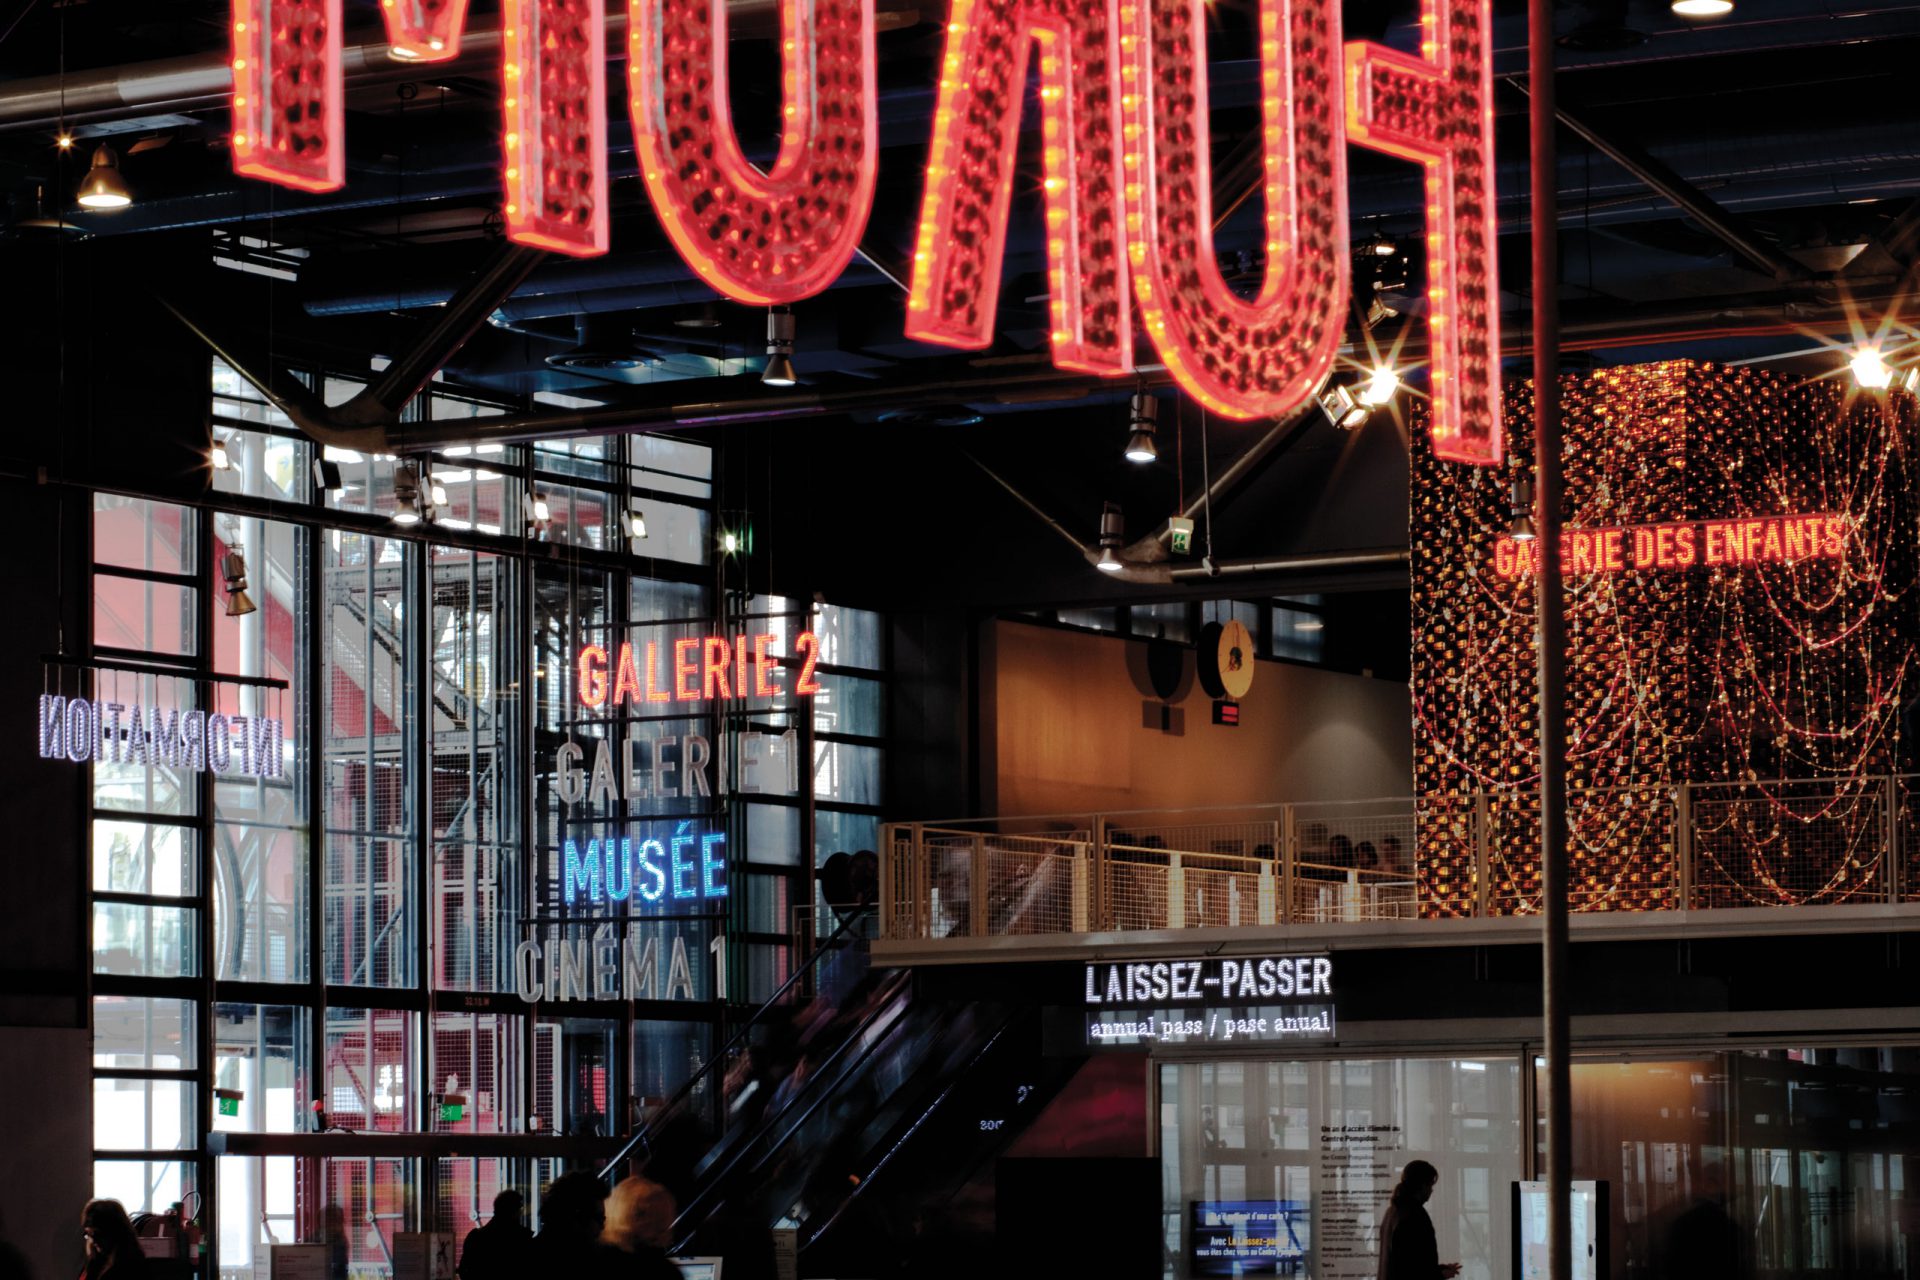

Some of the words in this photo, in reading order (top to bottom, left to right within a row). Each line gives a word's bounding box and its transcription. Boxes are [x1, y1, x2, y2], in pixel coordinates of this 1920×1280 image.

[1634, 525, 1694, 567] DES
[1704, 513, 1845, 563] ENFANTS
[578, 632, 781, 708] GALERIE
[795, 631, 821, 695] 2
[555, 731, 762, 805] GALERIE
[563, 820, 728, 903] MUSÉE
[515, 922, 696, 1003] CINÉMA
[710, 935, 728, 1000] 1
[1086, 957, 1332, 1003] LAISSEZ-PASSER
[1091, 1016, 1156, 1038] annual
[1161, 1021, 1203, 1041] pass
[1209, 1013, 1217, 1038] /
[1223, 1017, 1267, 1040] pase
[1274, 1010, 1331, 1033] anual
[1210, 1236, 1227, 1246] Avec
